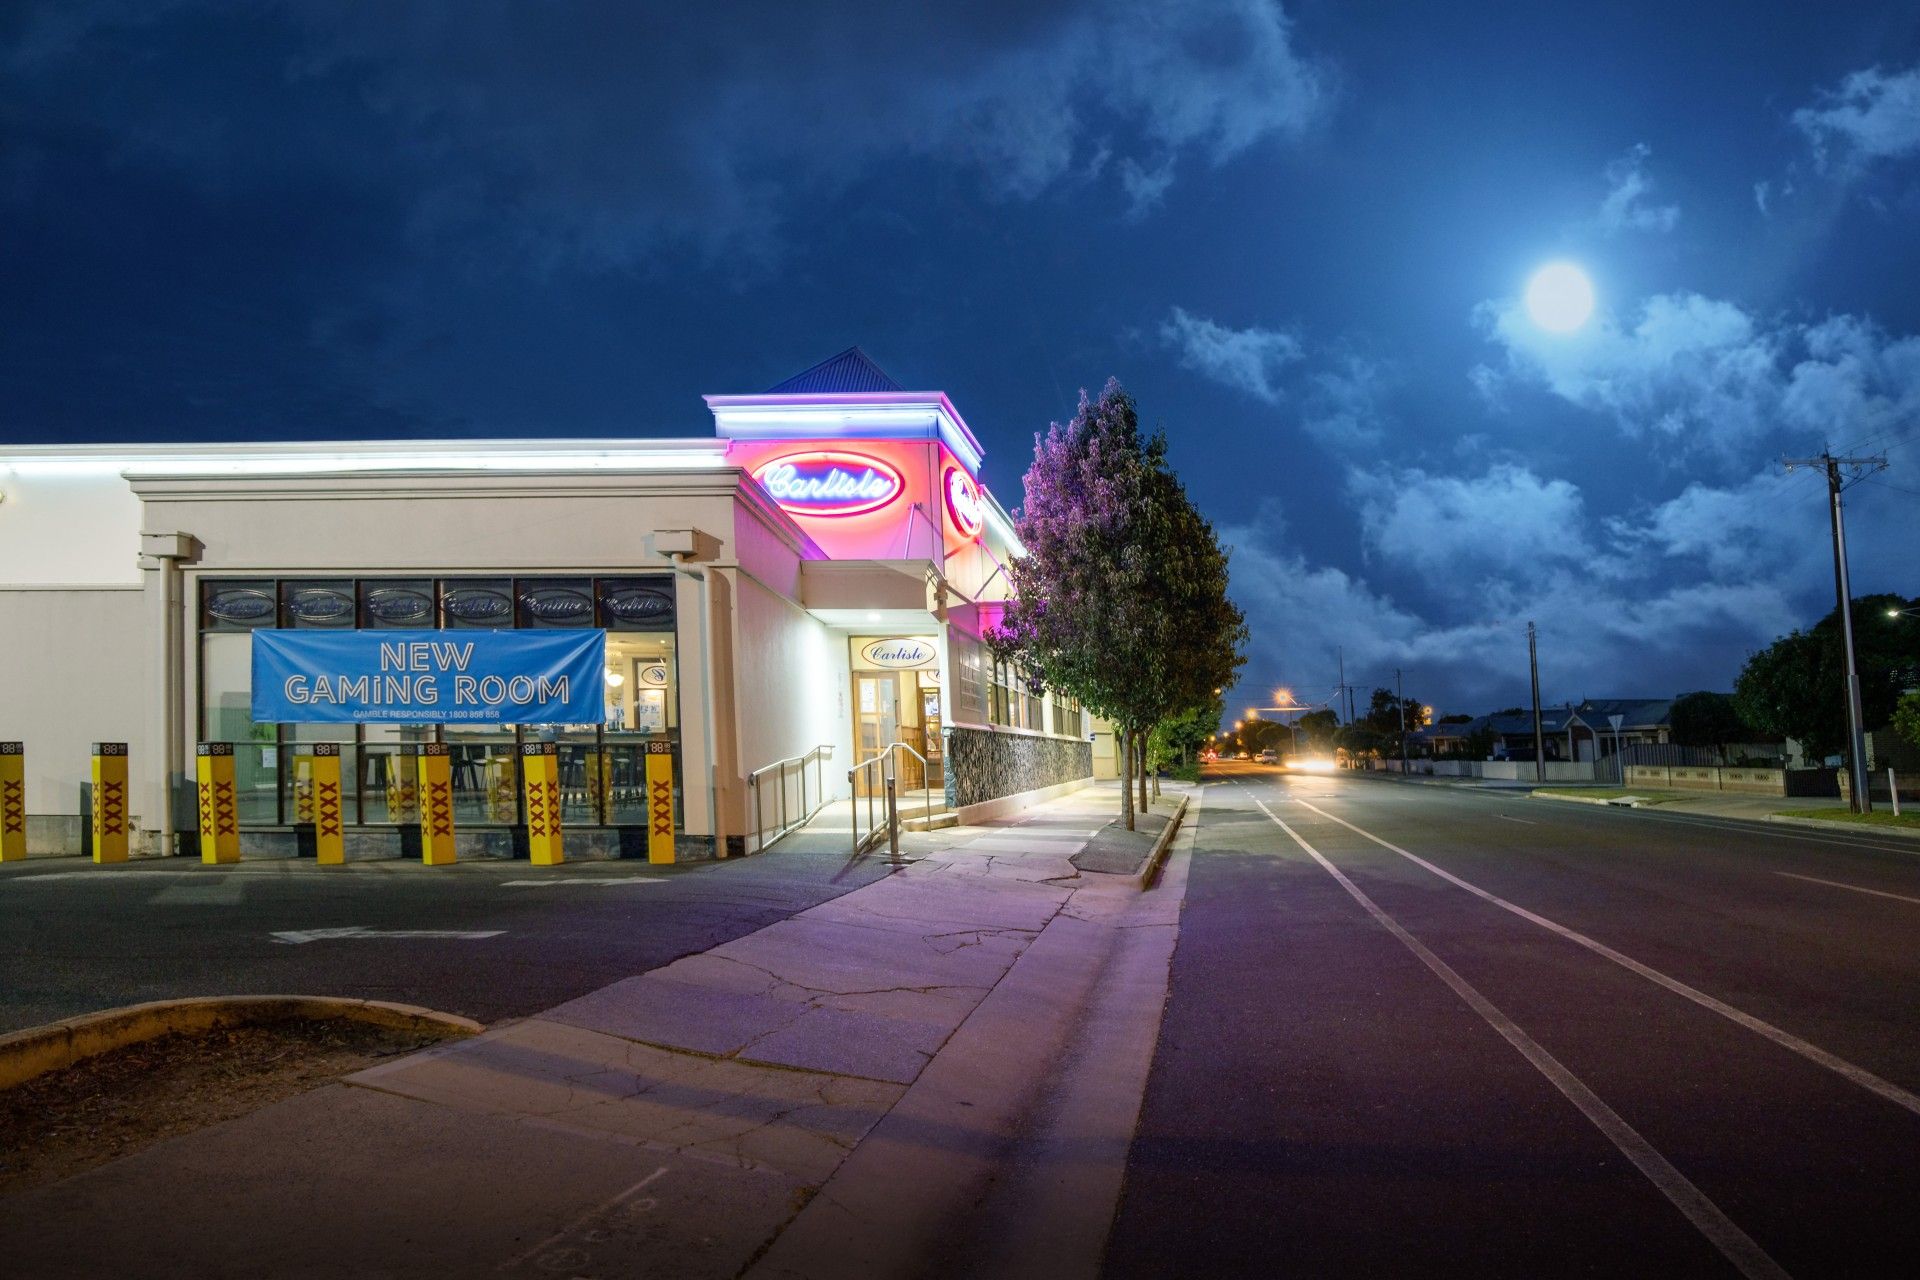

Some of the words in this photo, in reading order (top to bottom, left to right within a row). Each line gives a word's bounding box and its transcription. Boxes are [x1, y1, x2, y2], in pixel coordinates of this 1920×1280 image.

[763, 464, 892, 498] Carlisle
[380, 641, 474, 671] NEW
[870, 646, 926, 660] Carlisle
[284, 674, 438, 704] GAMING
[455, 674, 569, 704] ROOM
[353, 710, 388, 718] GAMBLE
[389, 710, 447, 718] RESPONSIBLY
[449, 710, 468, 718] 1800
[485, 710, 500, 718] 858
